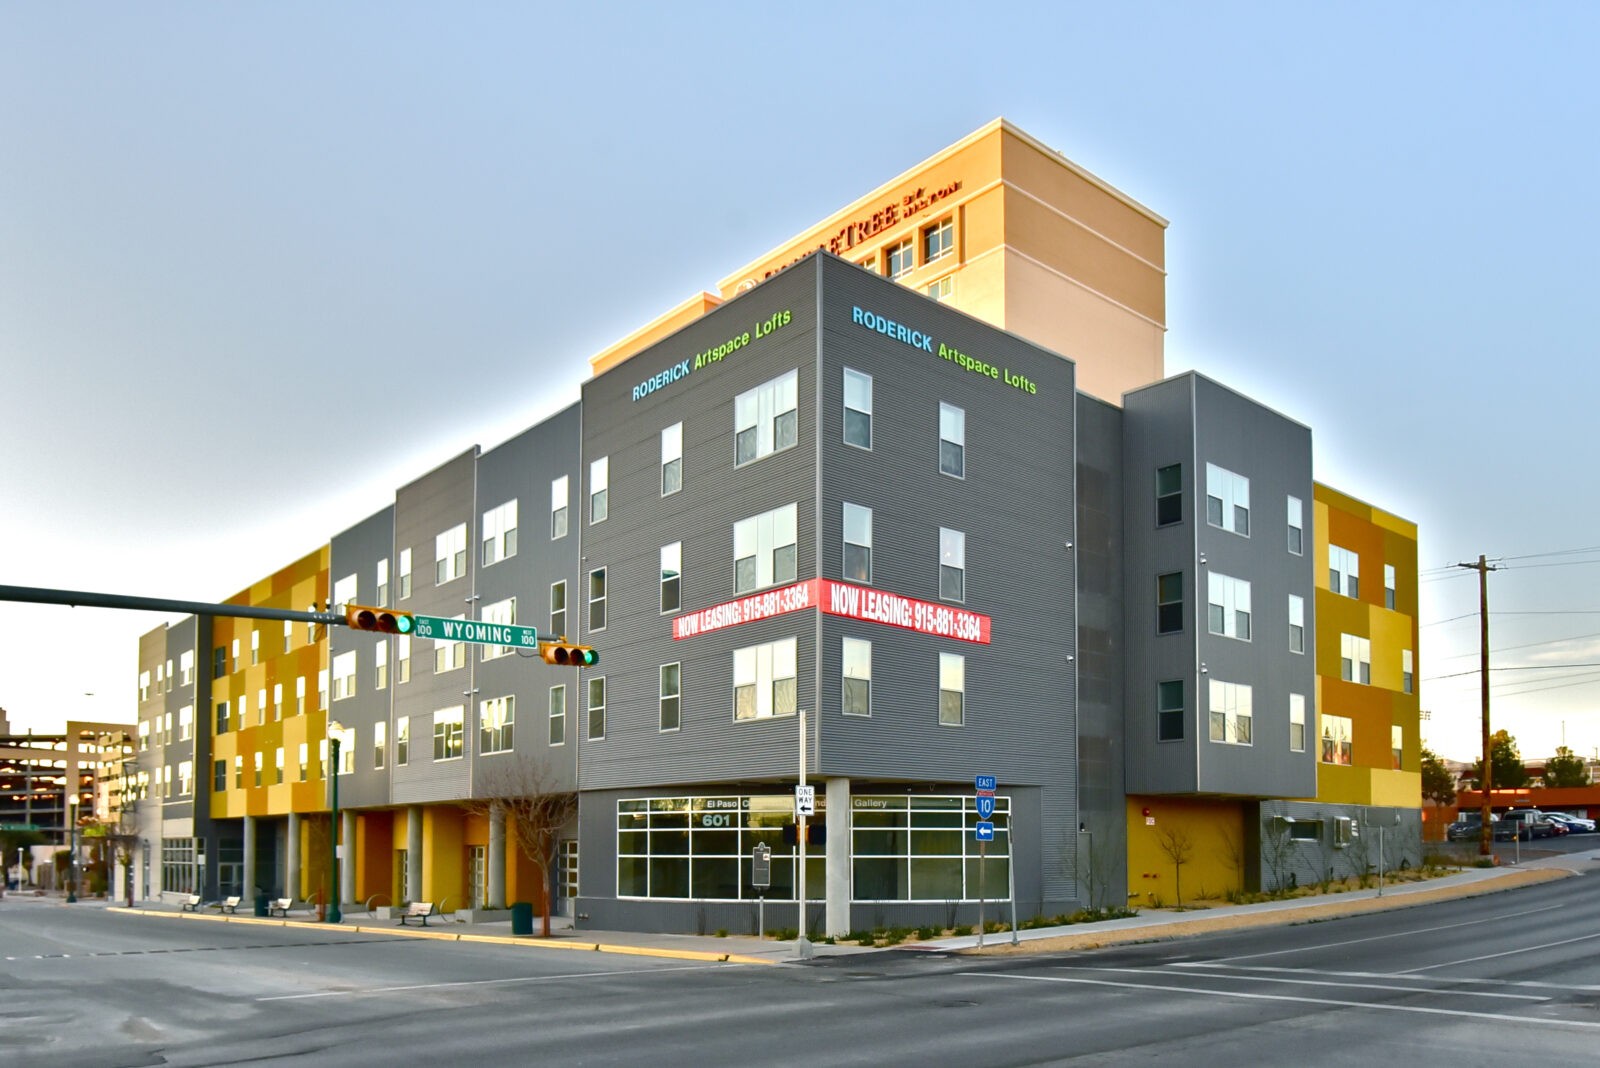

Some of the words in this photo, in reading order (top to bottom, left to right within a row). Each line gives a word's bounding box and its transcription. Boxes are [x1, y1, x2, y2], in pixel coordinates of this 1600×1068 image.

[903, 181, 959, 218] HILTON
[632, 359, 690, 401] RODERICK
[694, 331, 750, 370] Artspace
[755, 310, 792, 339] Lofts
[852, 306, 933, 352] RODERICK
[938, 342, 999, 379] Artspace
[1004, 368, 1037, 395] Lofts
[678, 614, 699, 638] NOW
[700, 601, 742, 632] LEASING:
[743, 583, 809, 622] 915-881-3364
[831, 583, 859, 616] NOW
[861, 590, 913, 628] LEASING:
[914, 602, 981, 642] 915-881-3364
[417, 624, 432, 636] 100
[442, 620, 512, 643] WYOMING
[521, 635, 535, 646] 100
[978, 777, 993, 788] EAST
[798, 788, 812, 797] ONE
[707, 800, 716, 808] El
[717, 799, 738, 808] Paso
[798, 797, 812, 805] WAY
[854, 799, 887, 809] Gallery
[980, 799, 991, 813] 10
[702, 813, 730, 827] 601
